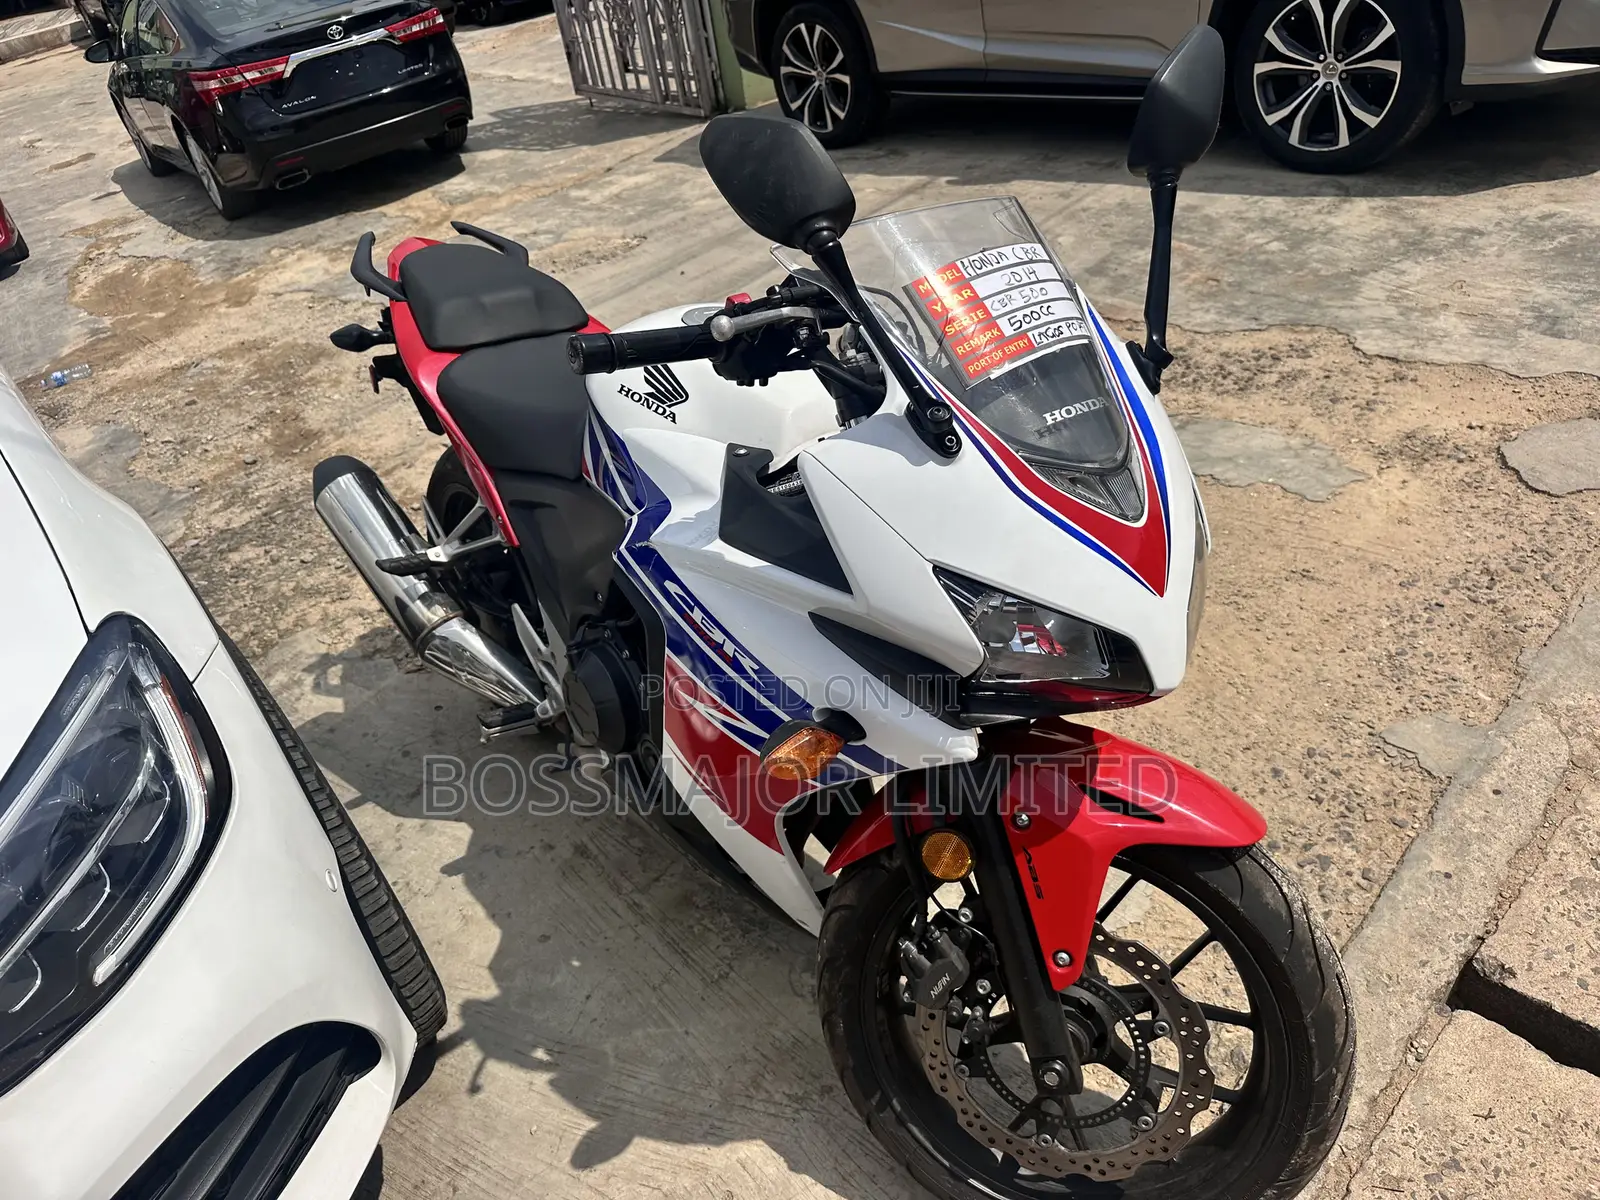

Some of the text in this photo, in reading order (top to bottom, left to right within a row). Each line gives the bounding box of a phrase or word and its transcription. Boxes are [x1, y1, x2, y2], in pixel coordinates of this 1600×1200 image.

[281, 95, 317, 109] AVALON
[918, 243, 1043, 293] MDEL HONDA CBR
[931, 265, 1040, 313] YAR 2014
[944, 286, 1048, 336] SERIE CBR 500
[956, 327, 1001, 356] REMARK
[967, 355, 991, 375] PORT
[991, 349, 1004, 362] OF
[1005, 338, 1030, 355] ENTRY
[617, 383, 678, 424] HONDA
[1042, 396, 1109, 425] HONDA
[663, 579, 765, 688] CBR
[1022, 846, 1045, 900] ABS
